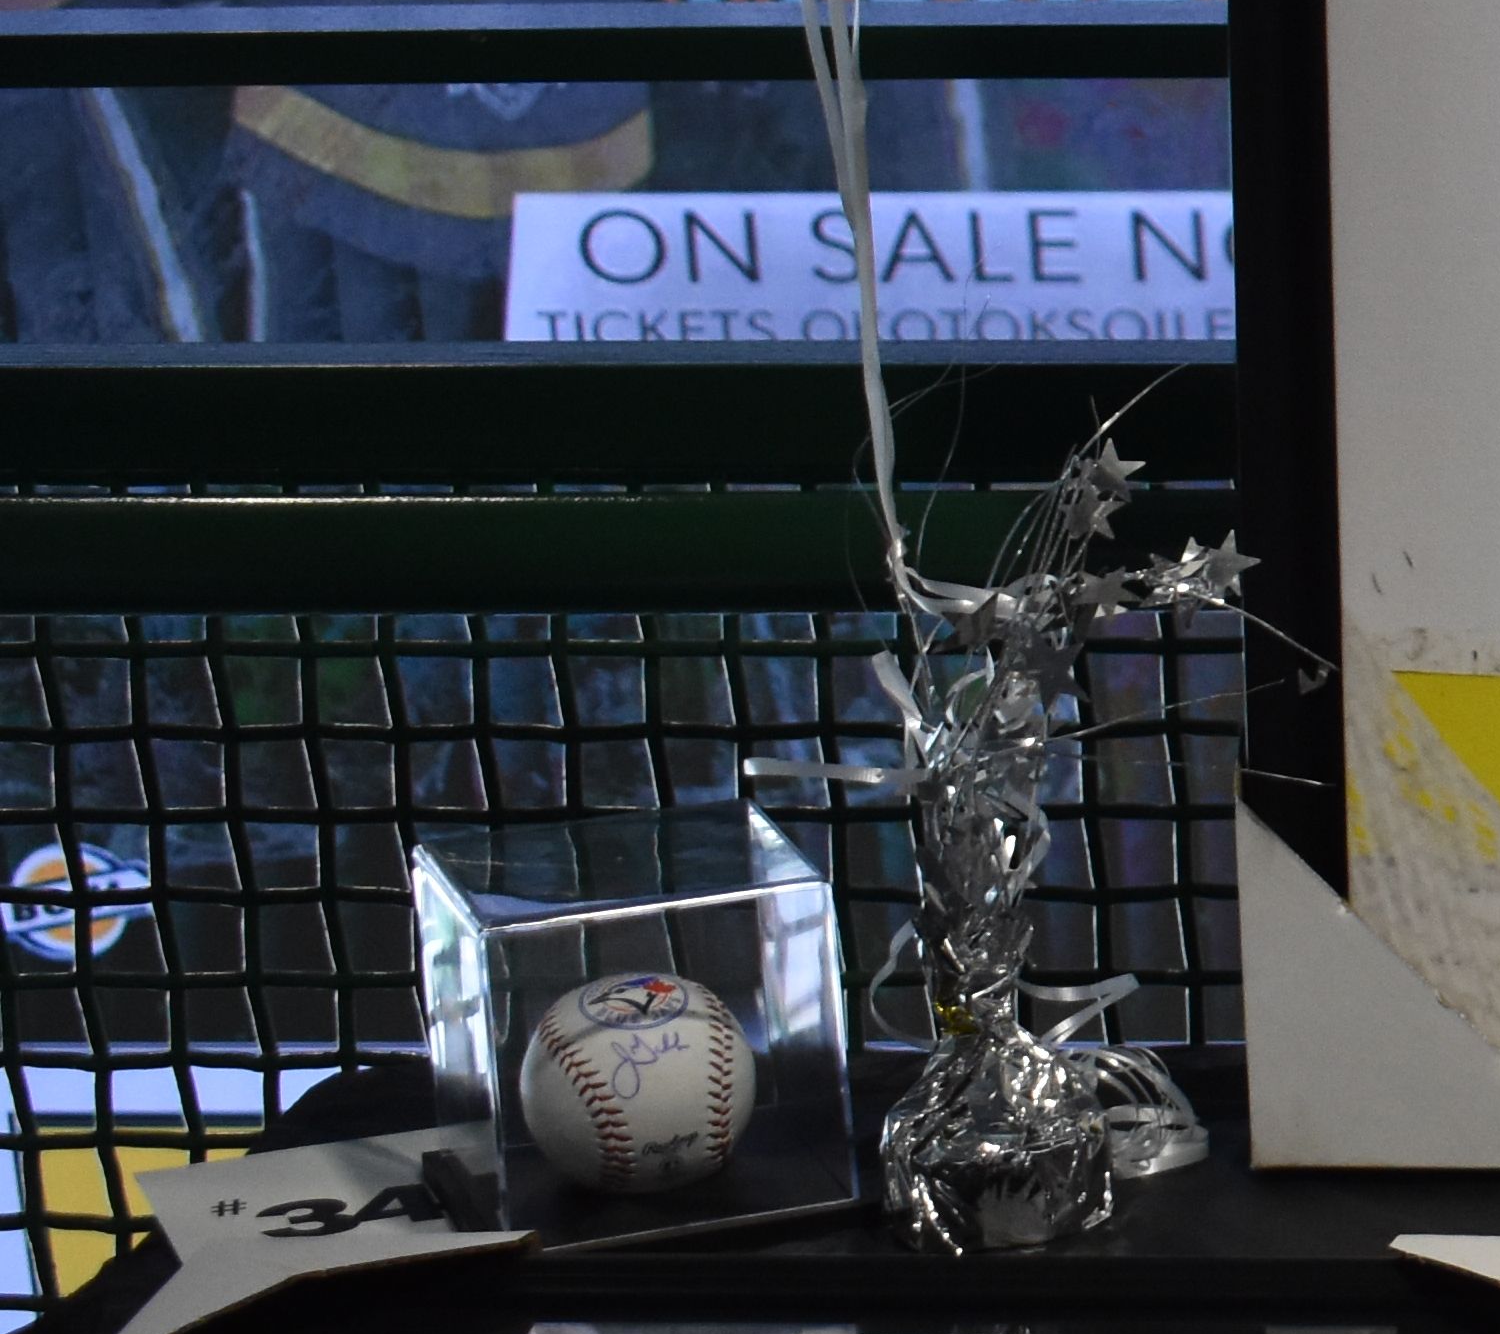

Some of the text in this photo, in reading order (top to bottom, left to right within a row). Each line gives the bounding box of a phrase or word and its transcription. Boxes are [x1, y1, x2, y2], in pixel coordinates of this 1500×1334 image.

[579, 207, 1231, 285] ON SALE N
[536, 309, 776, 340] TICKETS
[211, 1183, 448, 1238] #34
